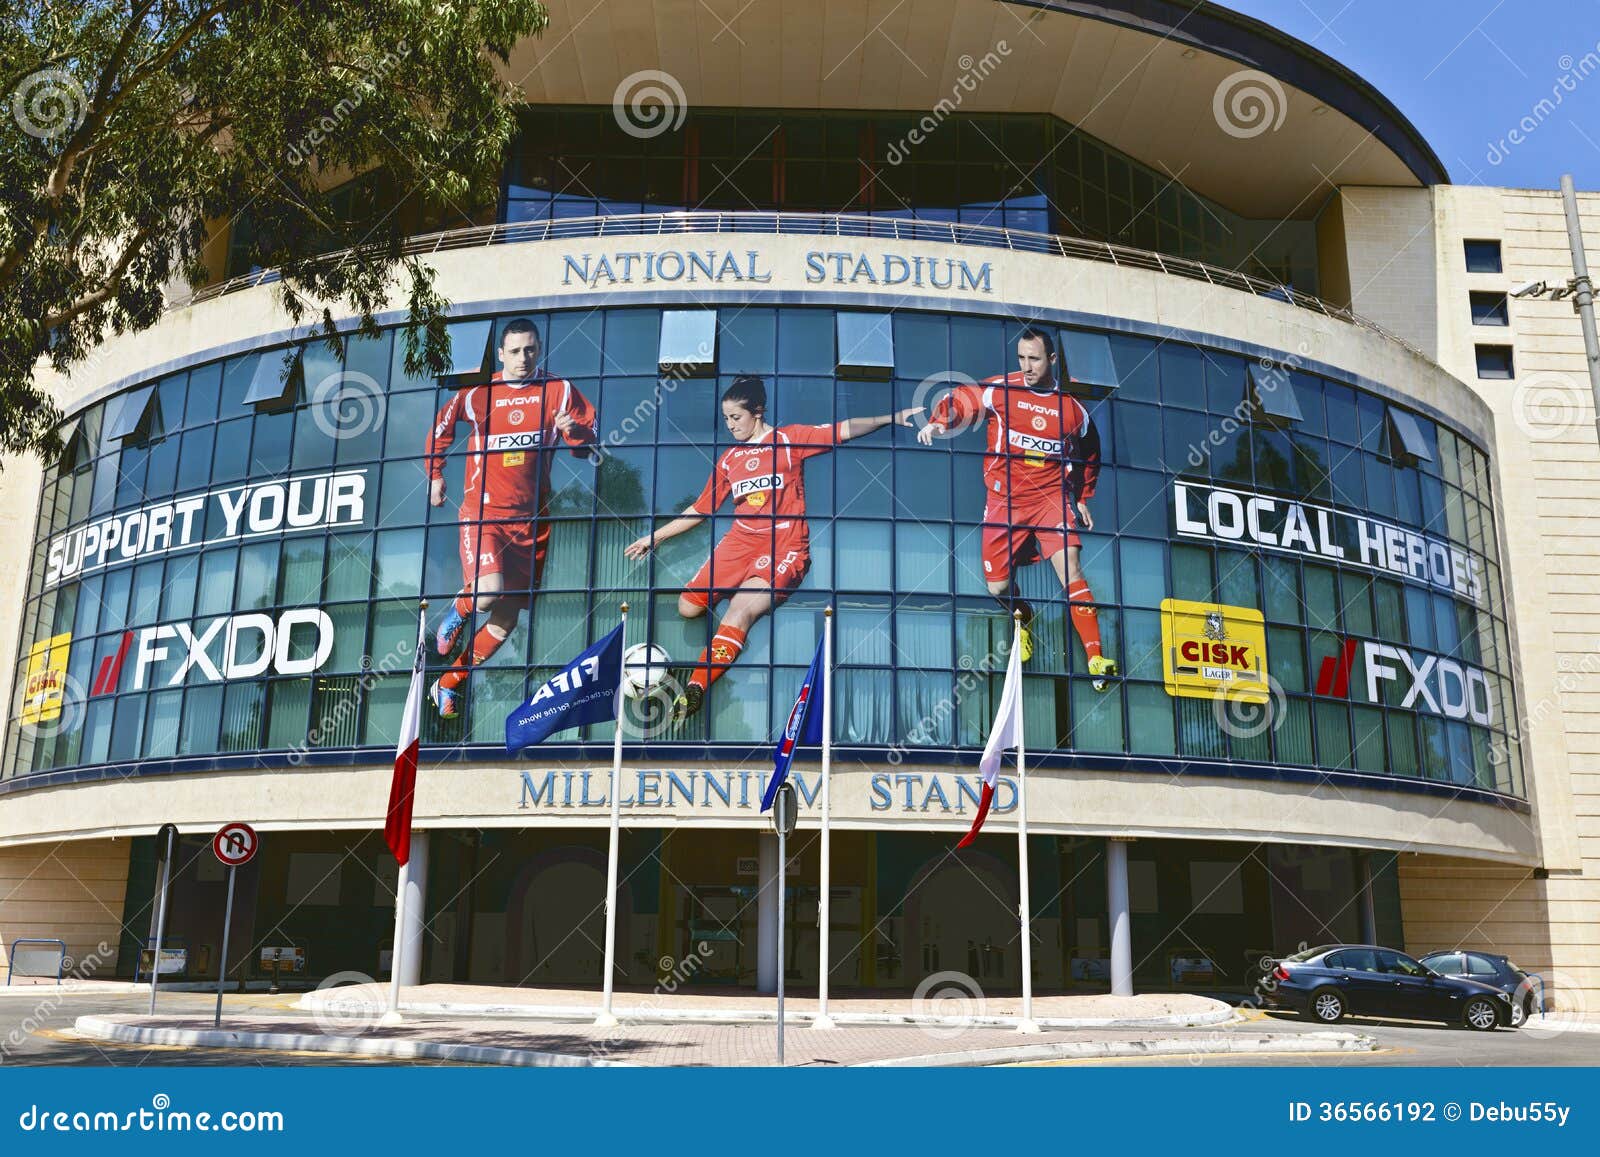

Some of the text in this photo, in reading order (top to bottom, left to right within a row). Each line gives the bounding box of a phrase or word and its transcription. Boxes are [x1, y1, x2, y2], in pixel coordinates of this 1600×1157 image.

[562, 250, 994, 293] NATIONAL STADIUM
[495, 395, 540, 408] GIVOVA
[1017, 401, 1060, 417] GIVOVA
[47, 473, 367, 581] SUPPORT YOUR
[1174, 482, 1482, 600] LOCAL HEROES
[1181, 640, 1249, 669] CISK
[29, 668, 60, 694] CISK
[1204, 667, 1231, 679] LAGER
[870, 773, 1019, 815] STAND
